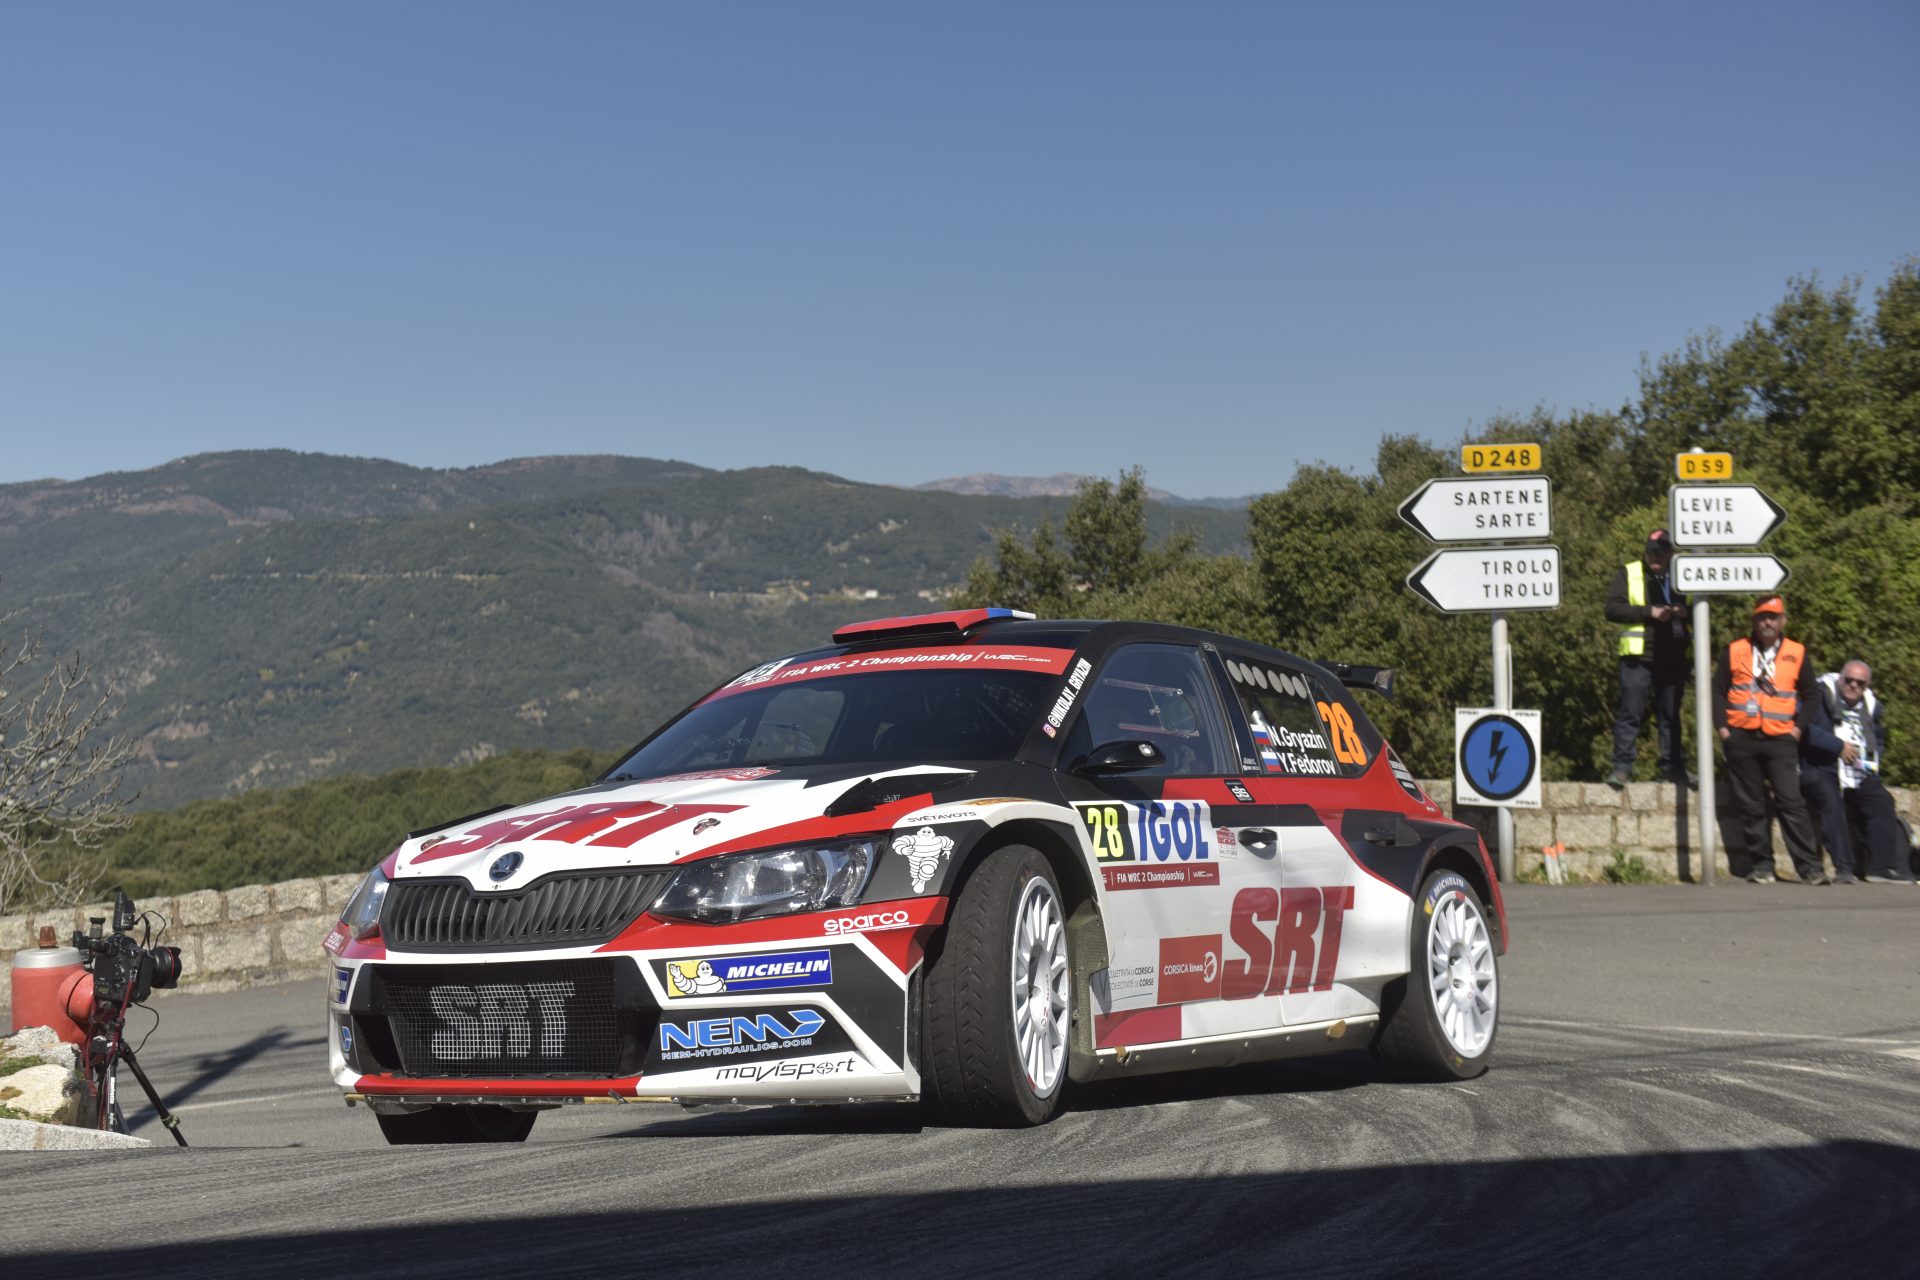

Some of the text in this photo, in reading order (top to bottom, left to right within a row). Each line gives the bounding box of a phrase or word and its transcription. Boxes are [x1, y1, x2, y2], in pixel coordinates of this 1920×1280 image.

[1454, 489, 1542, 506] SARTENE
[1680, 497, 1734, 512] LEVIE
[1680, 521, 1734, 535] LEVIA
[1482, 559, 1552, 575] TIROLO
[1682, 566, 1762, 581] CARBINI
[1483, 581, 1553, 598] TIROLU
[781, 667, 809, 679] FIA
[810, 661, 847, 673] WRC
[846, 659, 860, 668] 2
[860, 652, 973, 666] Championship
[1316, 701, 1368, 766] 28
[1087, 807, 1125, 858] 28
[1135, 801, 1209, 862] IGOL
[1116, 873, 1127, 884] FIA
[1146, 870, 1185, 883] Championship
[823, 910, 910, 934] sparco
[1220, 886, 1355, 1001] SRT
[726, 958, 830, 979] MICHELIN
[1163, 964, 1189, 975] CORSICA
[661, 1037, 812, 1060] NEM-HYDRAULICS.COM
